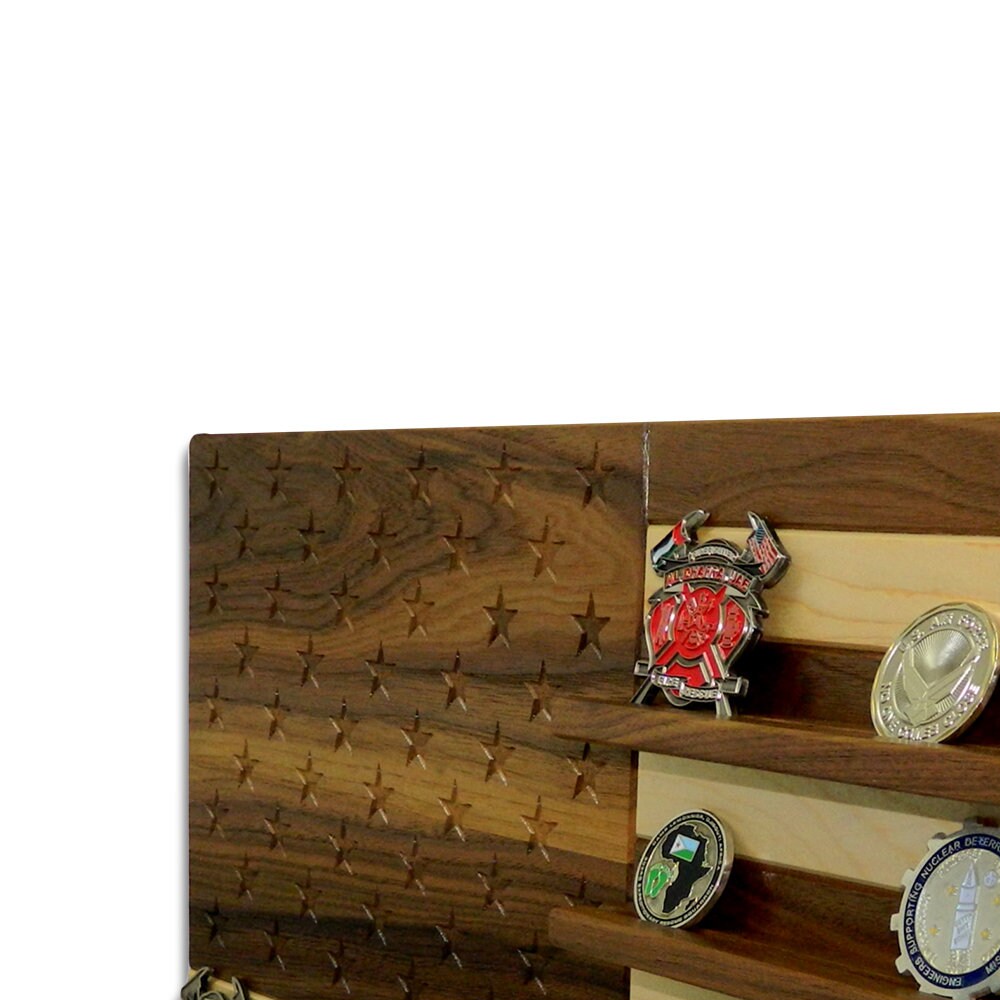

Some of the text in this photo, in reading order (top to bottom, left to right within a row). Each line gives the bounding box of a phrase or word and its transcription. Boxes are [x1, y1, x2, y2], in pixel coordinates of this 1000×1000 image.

[920, 841, 961, 879] NUCLEAR
[905, 884, 923, 956] SUPPORTING
[914, 956, 962, 987] ENGINEERS
